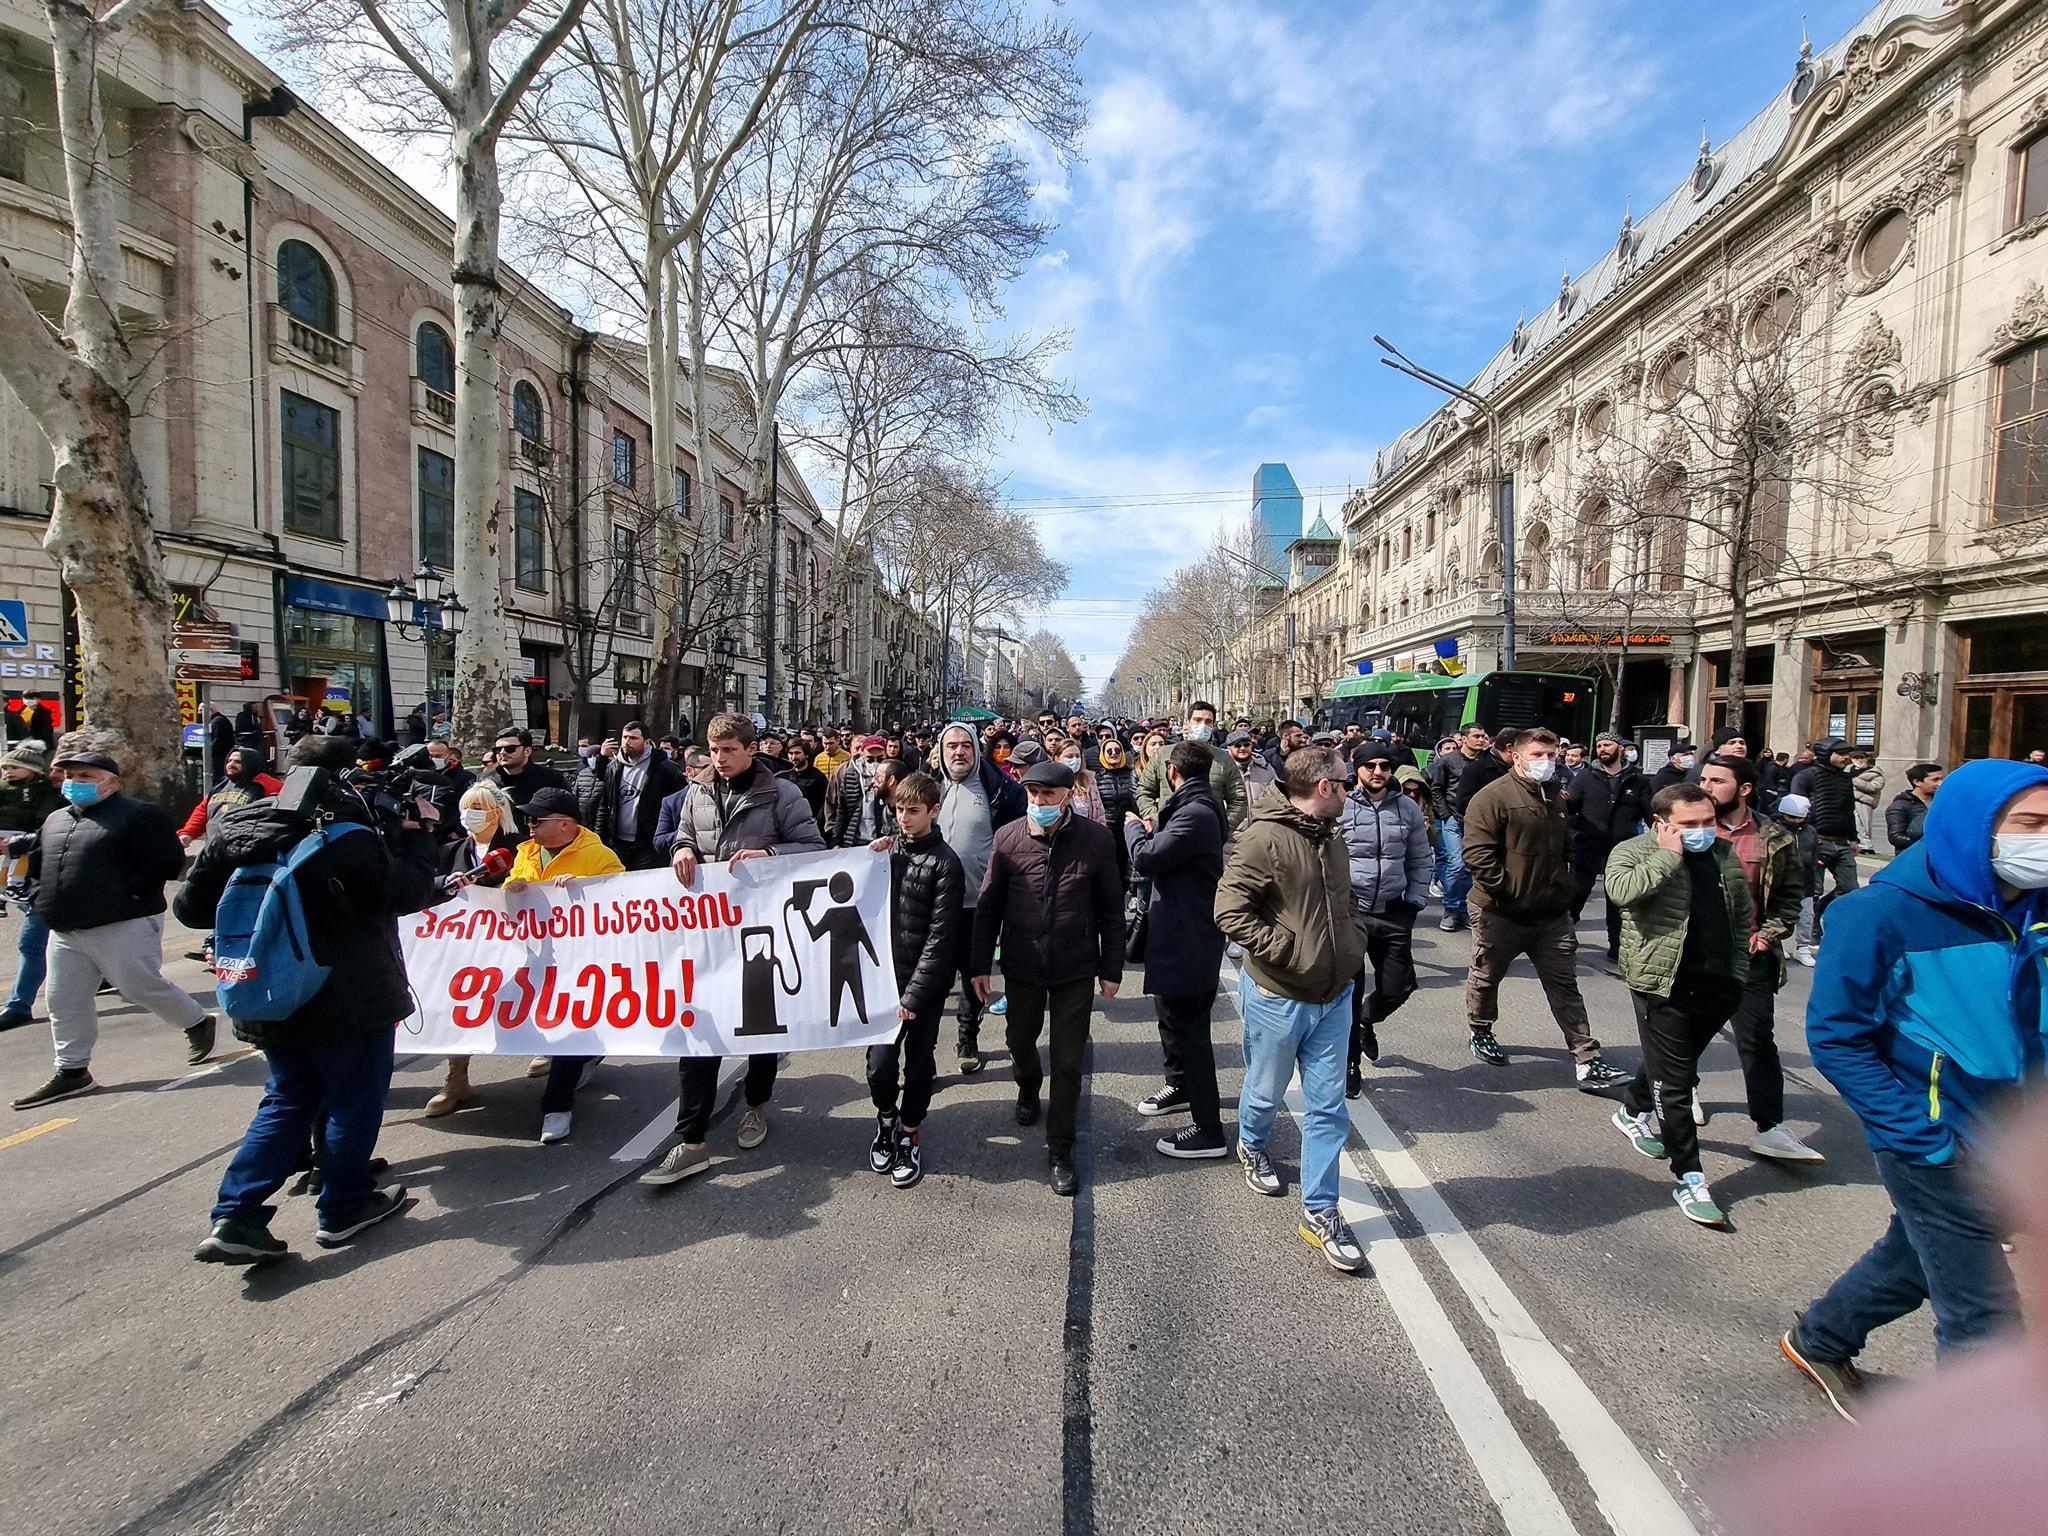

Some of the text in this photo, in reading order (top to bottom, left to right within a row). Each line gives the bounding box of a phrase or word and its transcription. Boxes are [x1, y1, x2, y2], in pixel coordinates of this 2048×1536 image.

[414, 891, 742, 941] პროტესტი საწვავის
[449, 958, 696, 1029] ფასებს!
